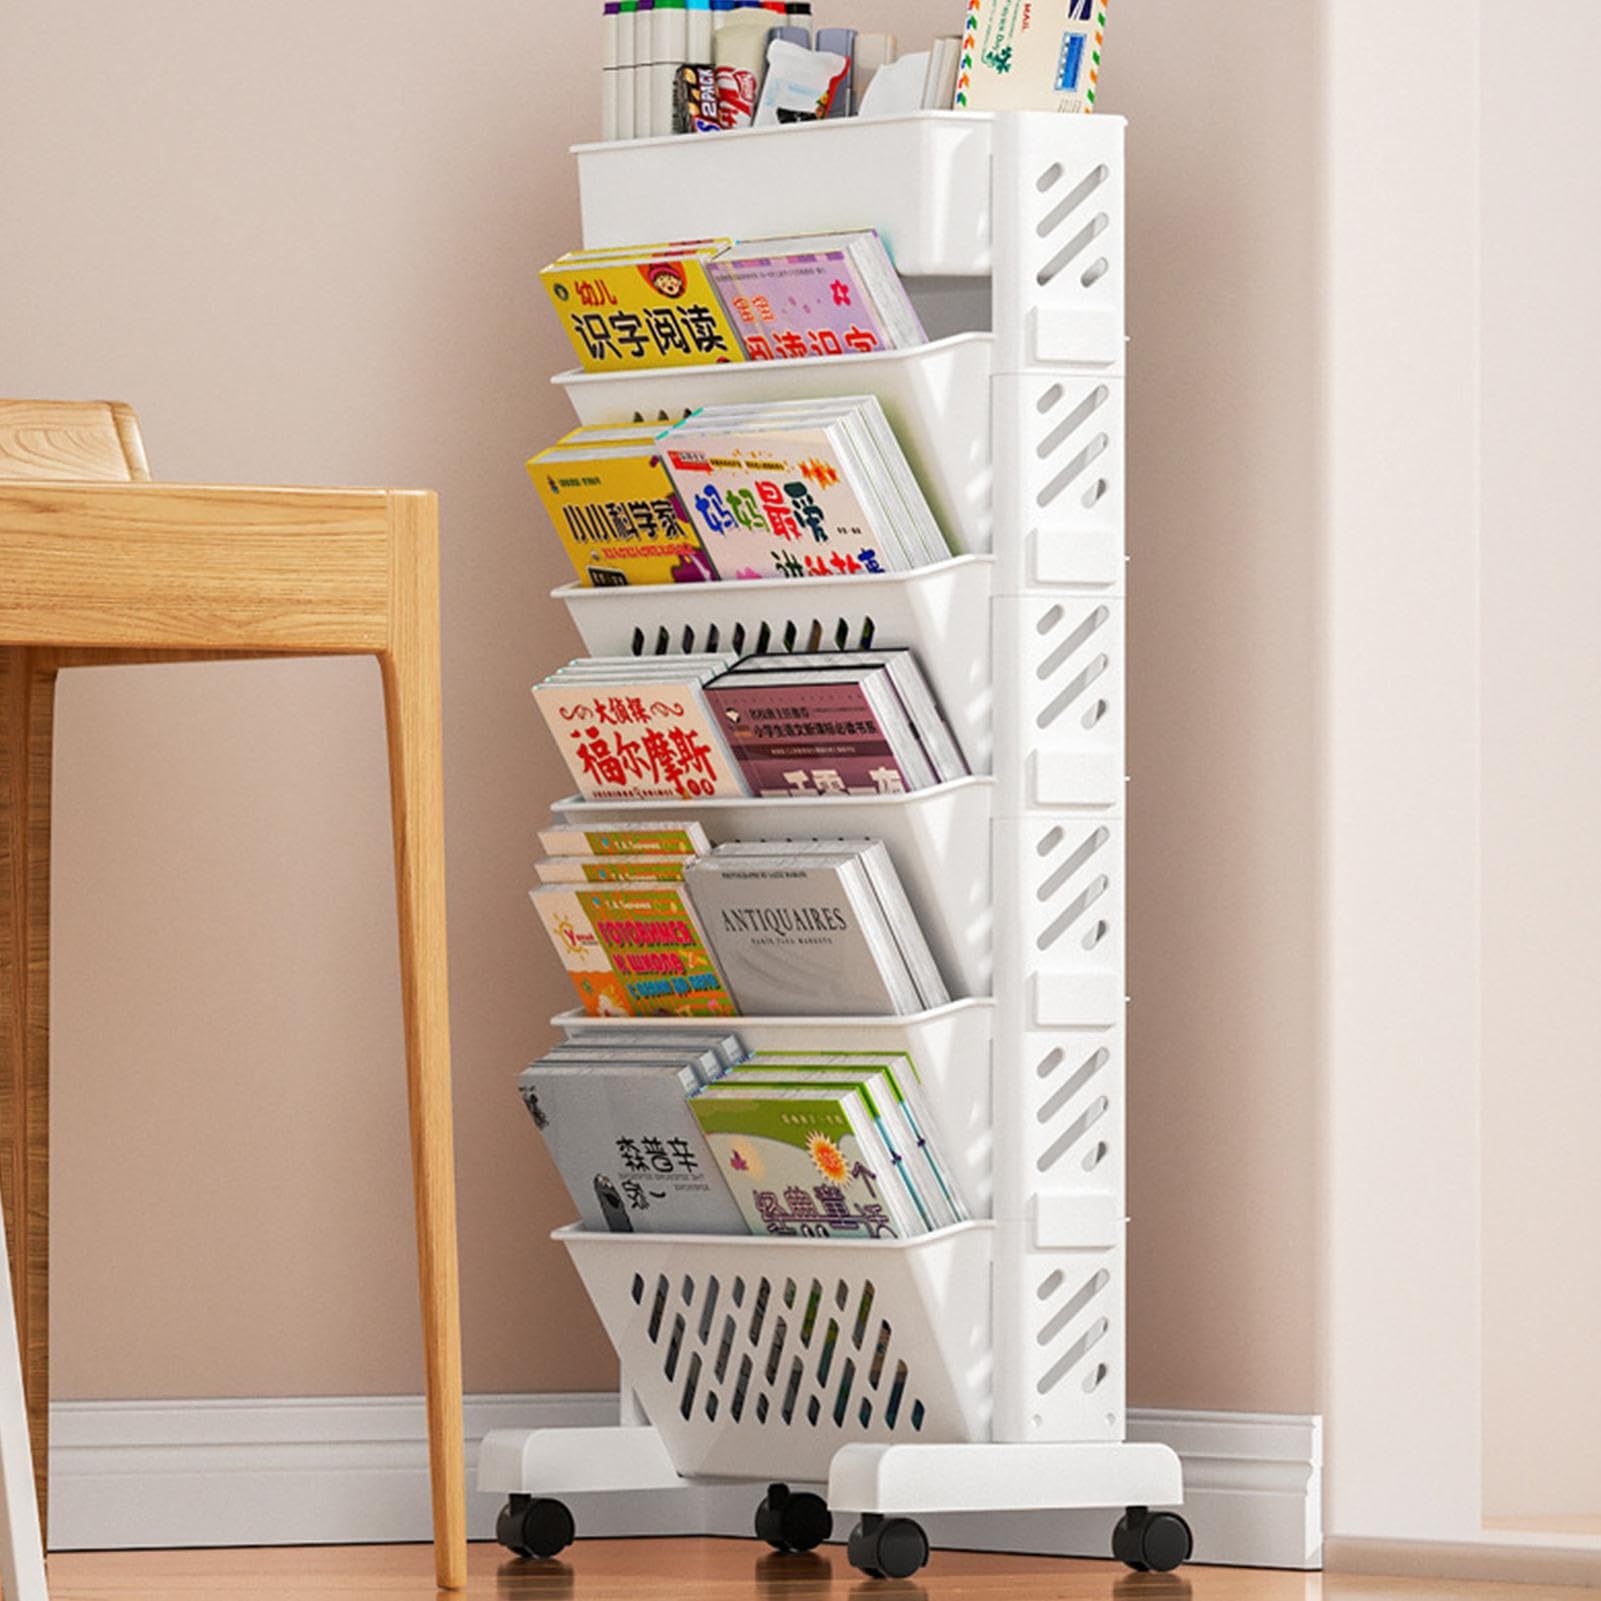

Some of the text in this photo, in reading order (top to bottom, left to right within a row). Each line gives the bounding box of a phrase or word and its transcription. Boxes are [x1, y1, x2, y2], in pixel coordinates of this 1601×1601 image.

[574, 279, 618, 307] 幼儿
[571, 303, 728, 361] 识字阅读
[562, 499, 687, 543] 小小科学家
[694, 480, 829, 543] 妈妈最爱
[570, 726, 717, 791] 福尔摩斯
[721, 907, 848, 936] ANTIQUAIRES
